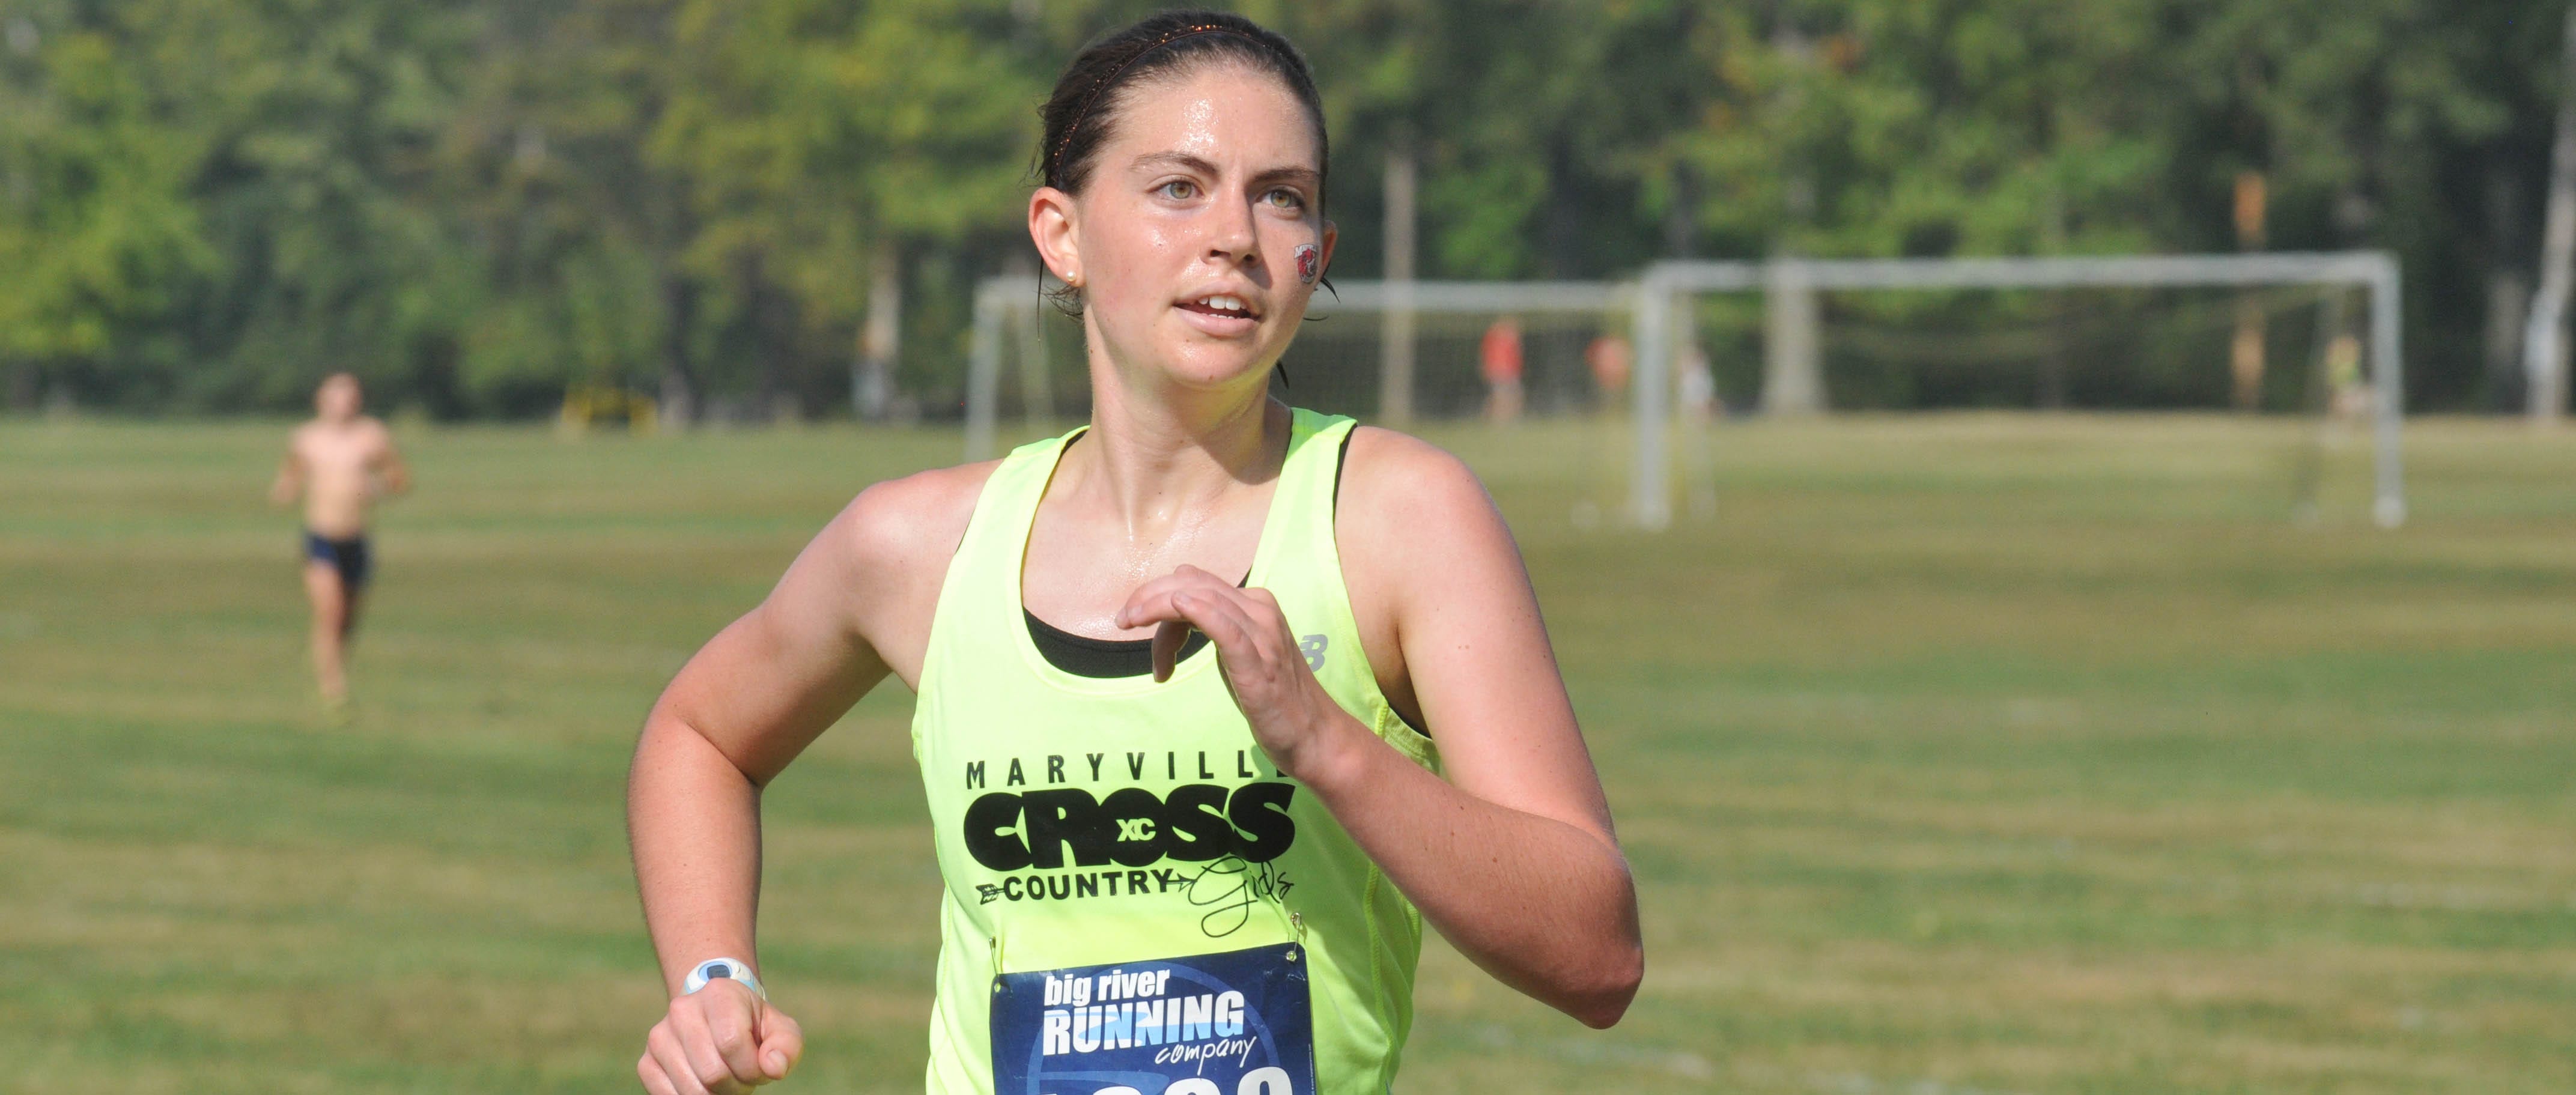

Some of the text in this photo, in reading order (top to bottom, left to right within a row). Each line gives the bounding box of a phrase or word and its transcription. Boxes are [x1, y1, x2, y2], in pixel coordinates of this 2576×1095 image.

[966, 750, 1289, 790] MARYVILL
[963, 782, 1296, 871] CROSS
[1116, 817, 1156, 842] XC
[1003, 869, 1174, 901] COUNTRY
[1043, 968, 1171, 1007] big river
[1042, 990, 1245, 1056] RUNNING
[1155, 1036, 1257, 1076] company
